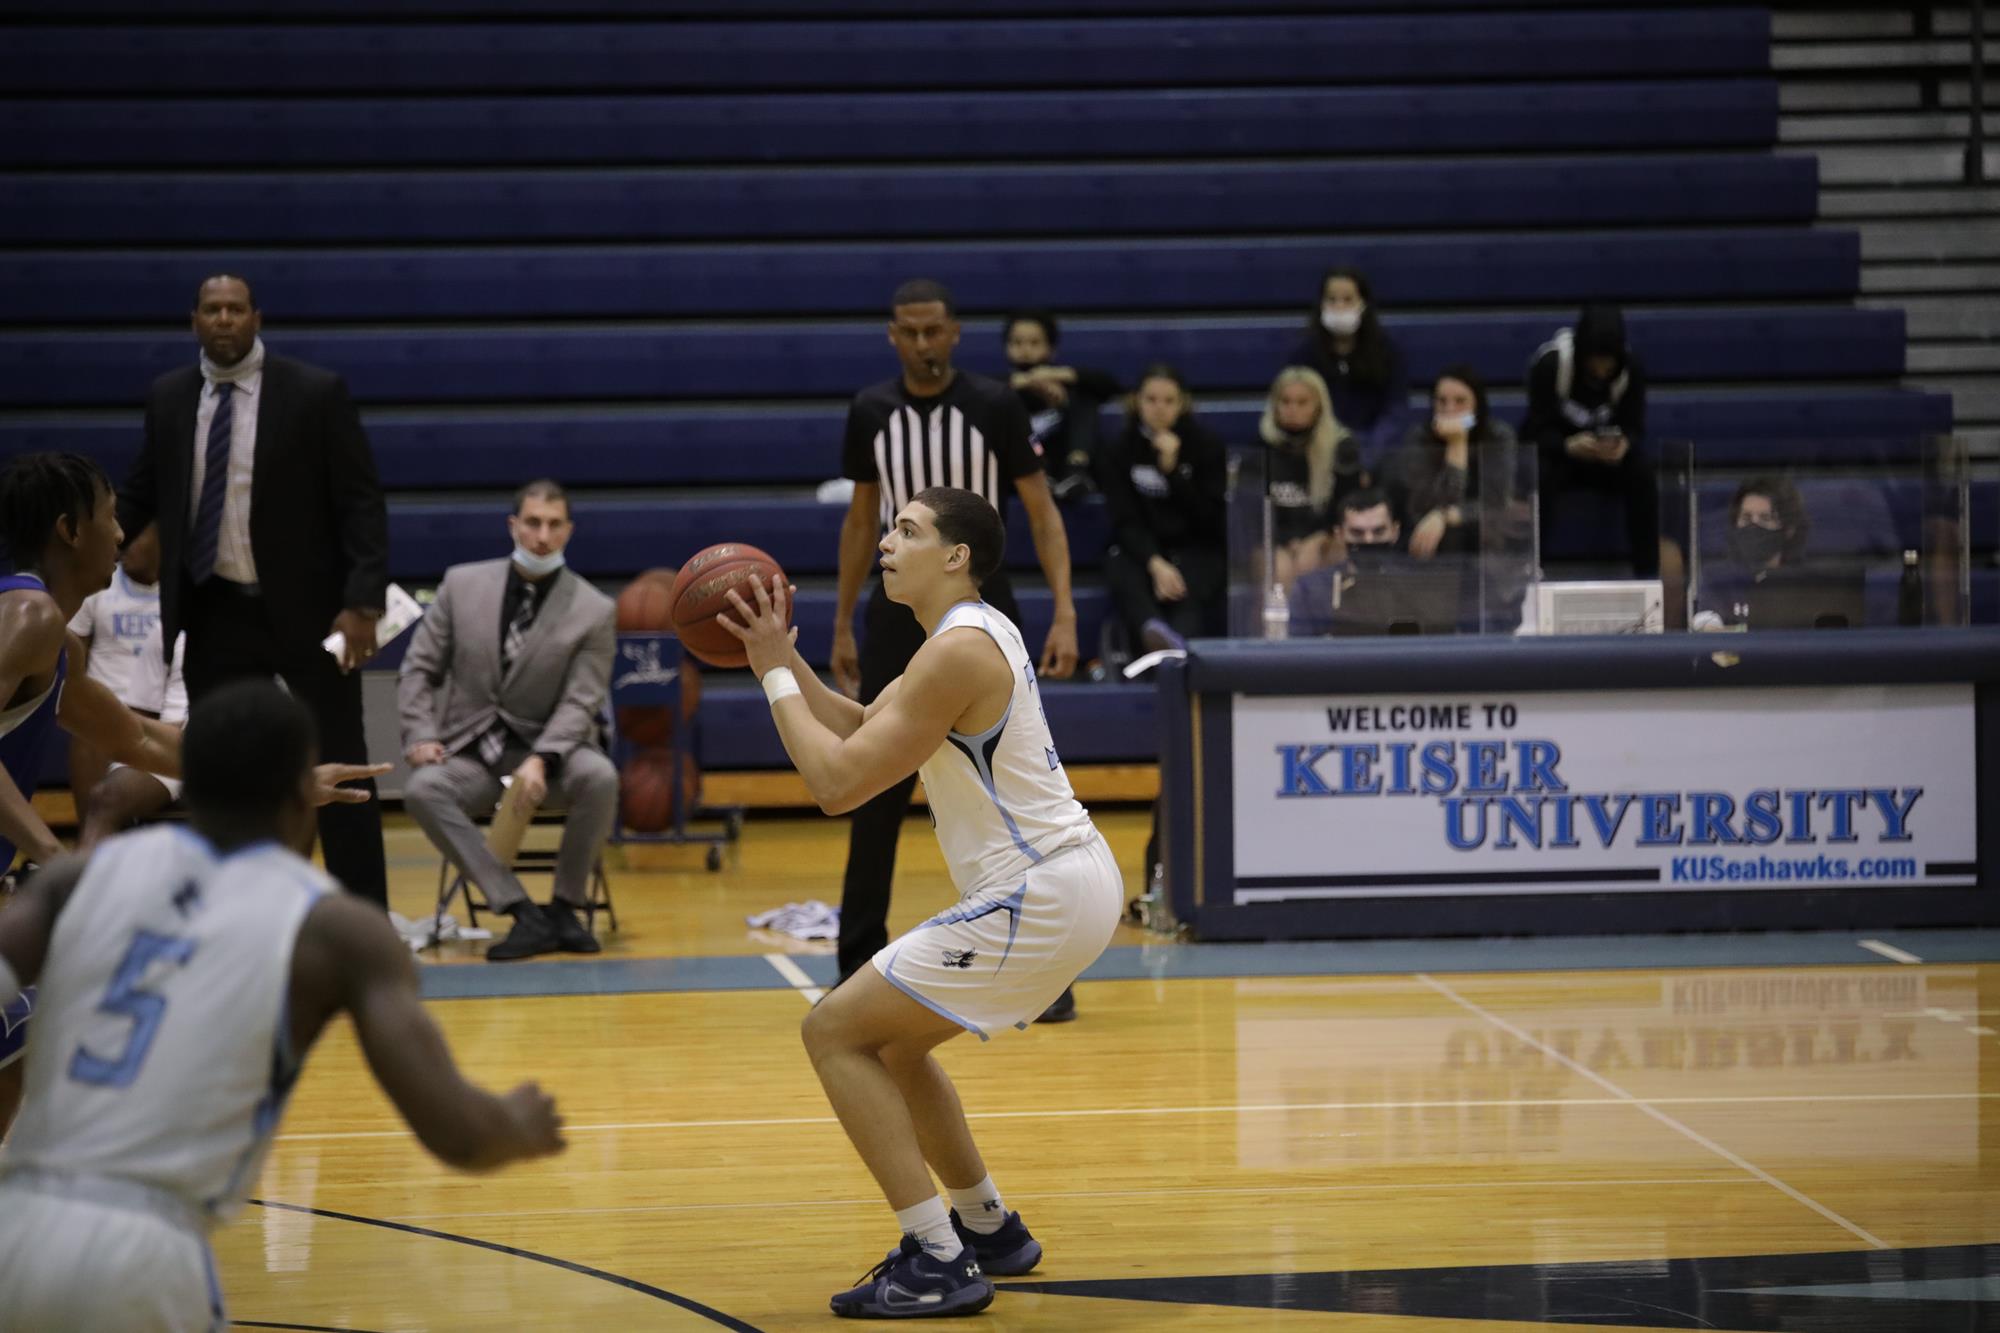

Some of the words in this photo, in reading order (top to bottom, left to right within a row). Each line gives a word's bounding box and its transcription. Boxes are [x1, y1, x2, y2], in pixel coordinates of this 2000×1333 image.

[112, 612, 160, 638] KEIS
[1327, 704, 1471, 732] WELCOME
[1483, 703, 1518, 728] TO
[1276, 739, 1568, 798] KEISER
[1440, 787, 1924, 850] UNIVERSITY
[1671, 855, 1916, 882] KUSeahawks.com
[68, 928, 198, 1088] 5
